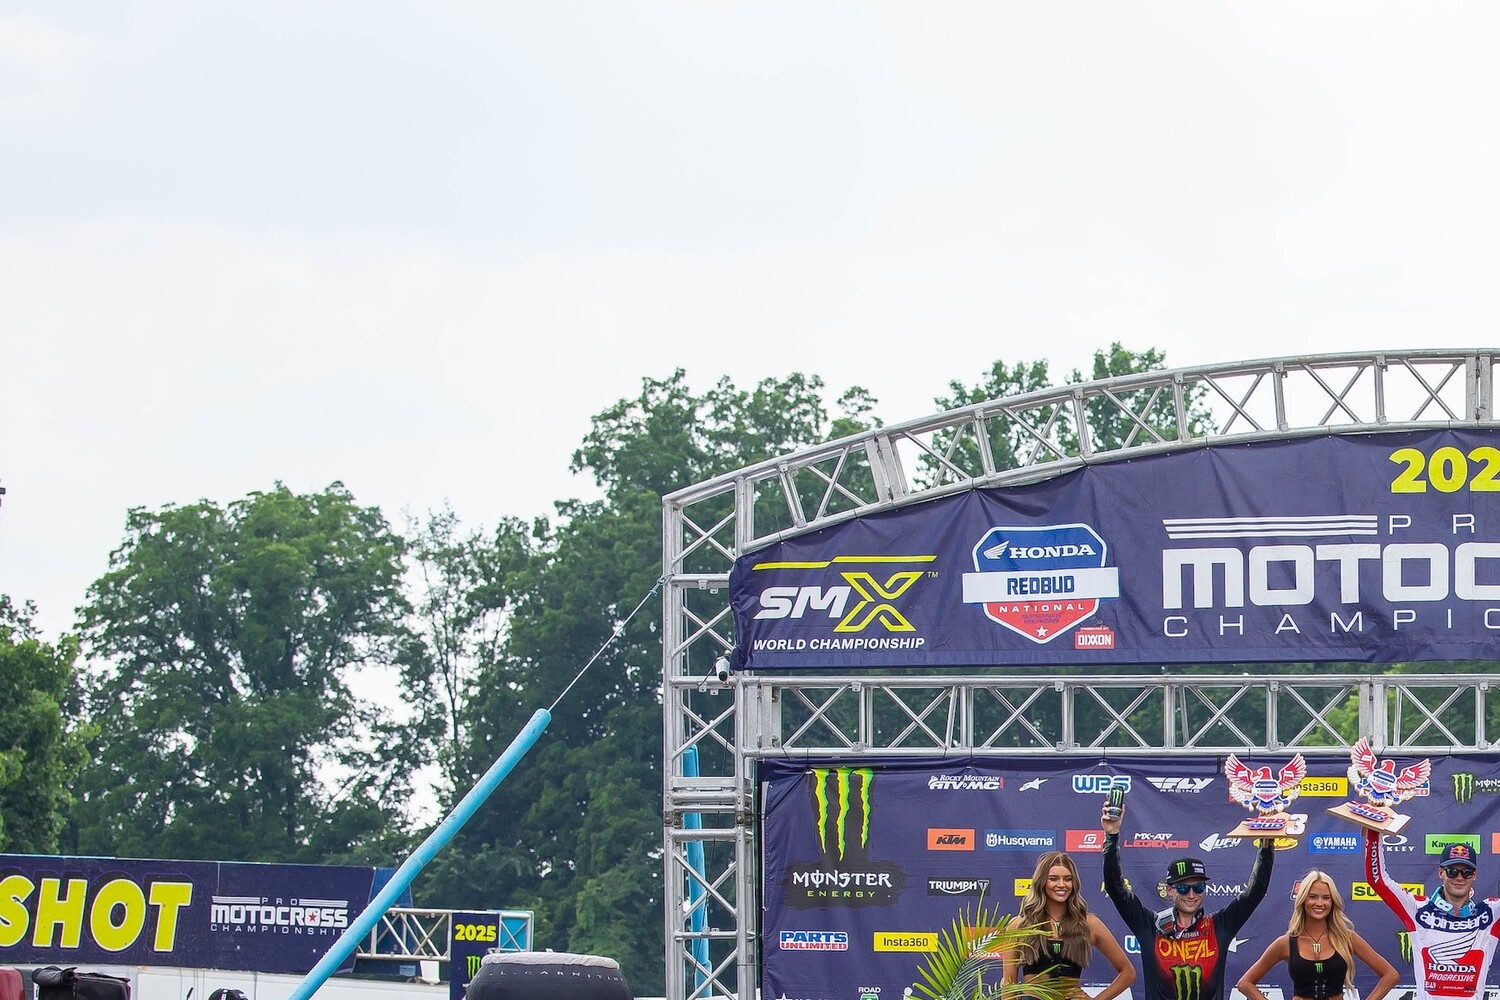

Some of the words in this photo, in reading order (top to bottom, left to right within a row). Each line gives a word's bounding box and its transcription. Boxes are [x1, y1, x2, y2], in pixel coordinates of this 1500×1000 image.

[1009, 543, 1097, 559] HONDA
[1007, 575, 1075, 596] REDBUD
[753, 571, 923, 633] SMX
[999, 602, 1086, 613] NATIONAL
[753, 638, 806, 651] WORLD
[810, 636, 925, 650] CHAMPIONSHIP
[1078, 631, 1112, 646] DIXXON
[1074, 775, 1131, 793] WPS
[1295, 782, 1338, 792] nsta360
[1286, 814, 1308, 835] 3
[936, 834, 966, 845] KTM
[998, 834, 1053, 847] Husqvarna
[1123, 840, 1190, 849] LEGENDS
[1323, 837, 1357, 847] YAMAHA
[1370, 841, 1380, 884] HONDA
[793, 869, 892, 889] MONSTER
[929, 880, 978, 892] TRIUMPH
[807, 890, 876, 898] ENERGY
[262, 897, 298, 906] PRO
[211, 904, 349, 928] MOTOCROSS
[1420, 909, 1490, 933] alpinestars
[455, 923, 497, 942] 2025
[781, 930, 848, 942] PARTS
[780, 942, 847, 950] UNLIMITED
[883, 937, 929, 947] Insta360
[1428, 962, 1477, 973] HONDA
[1428, 972, 1475, 983] PROGRESSIVE
[858, 986, 881, 994] ROAD
